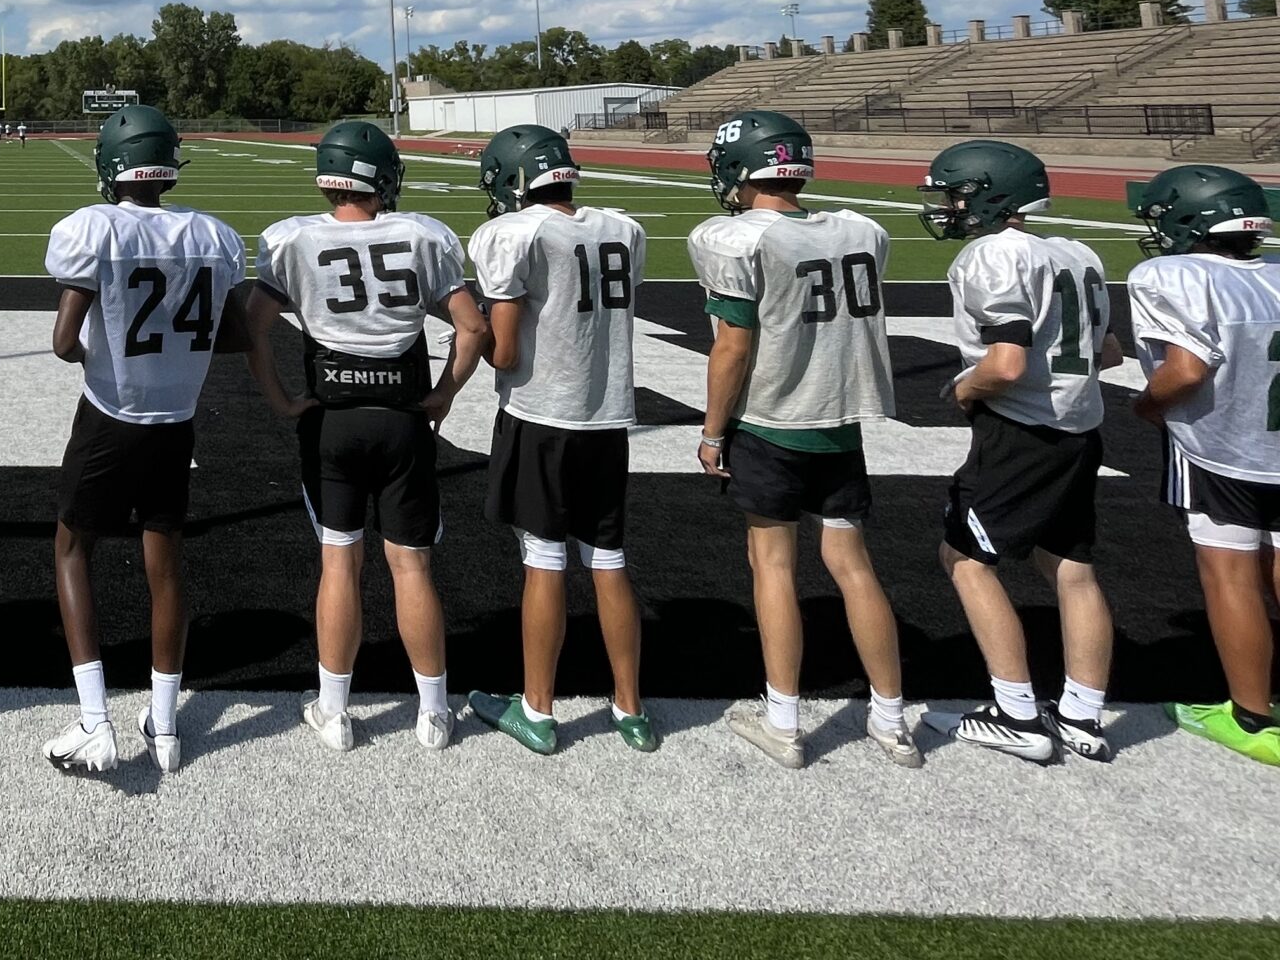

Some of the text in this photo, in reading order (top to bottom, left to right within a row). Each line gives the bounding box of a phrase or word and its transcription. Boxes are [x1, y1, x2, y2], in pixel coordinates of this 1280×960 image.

[715, 120, 743, 144] 56
[135, 170, 174, 179] Riddell
[125, 267, 214, 357] 24
[318, 241, 420, 313] 35
[574, 242, 631, 312] 18
[795, 252, 881, 324] 30
[324, 369, 402, 384] XENITH
